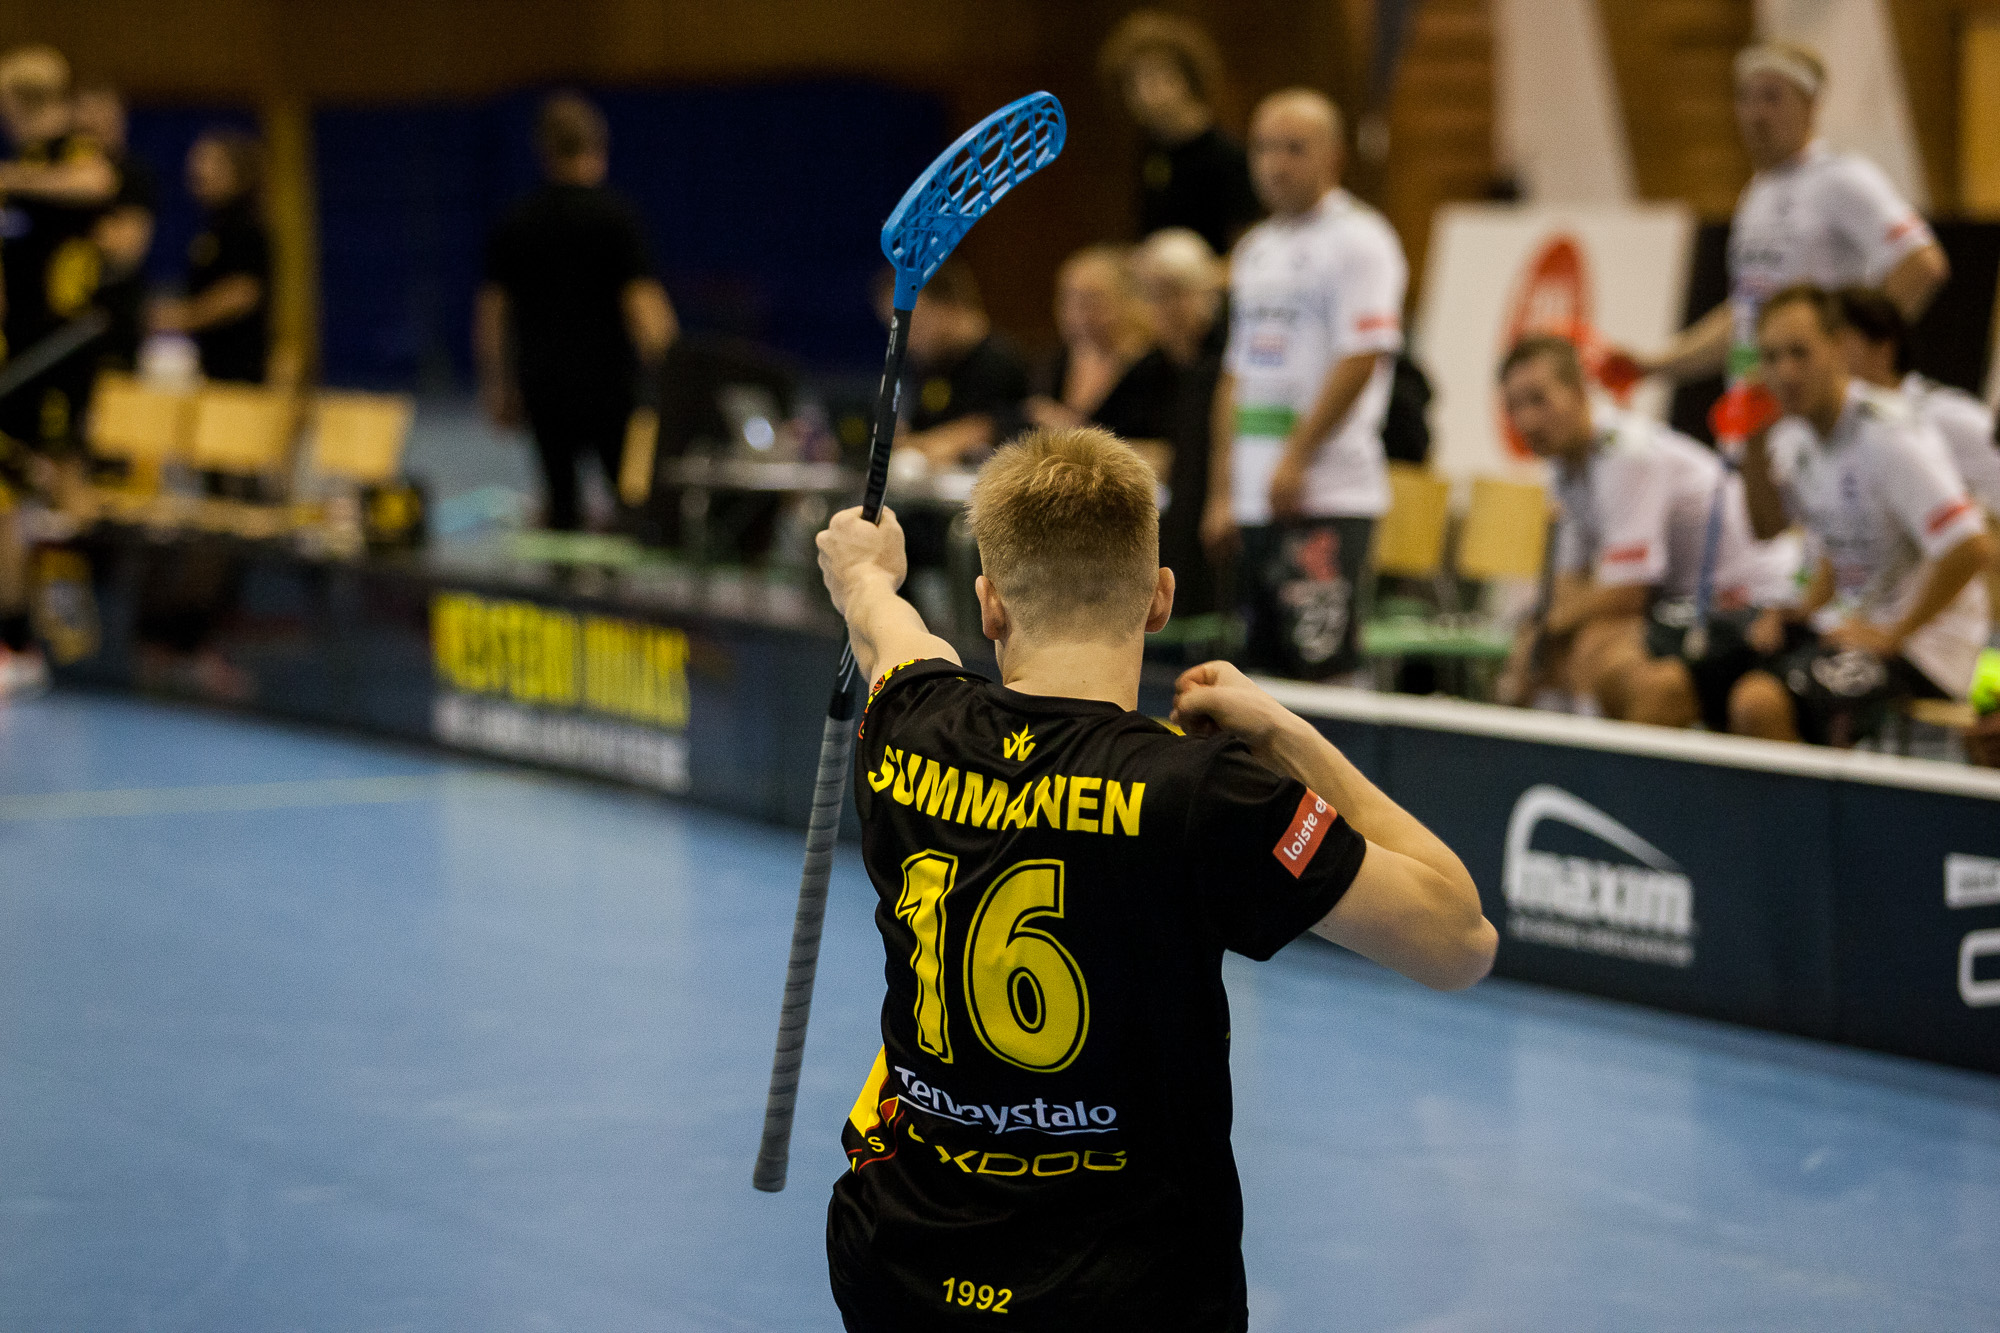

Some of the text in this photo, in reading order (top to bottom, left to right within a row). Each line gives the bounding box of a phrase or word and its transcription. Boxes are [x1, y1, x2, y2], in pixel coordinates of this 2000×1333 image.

[868, 745, 1146, 836] SUMMANEN
[1283, 812, 1318, 860] loiste
[895, 848, 1090, 1073] 16
[943, 1277, 1013, 1314] 1992
